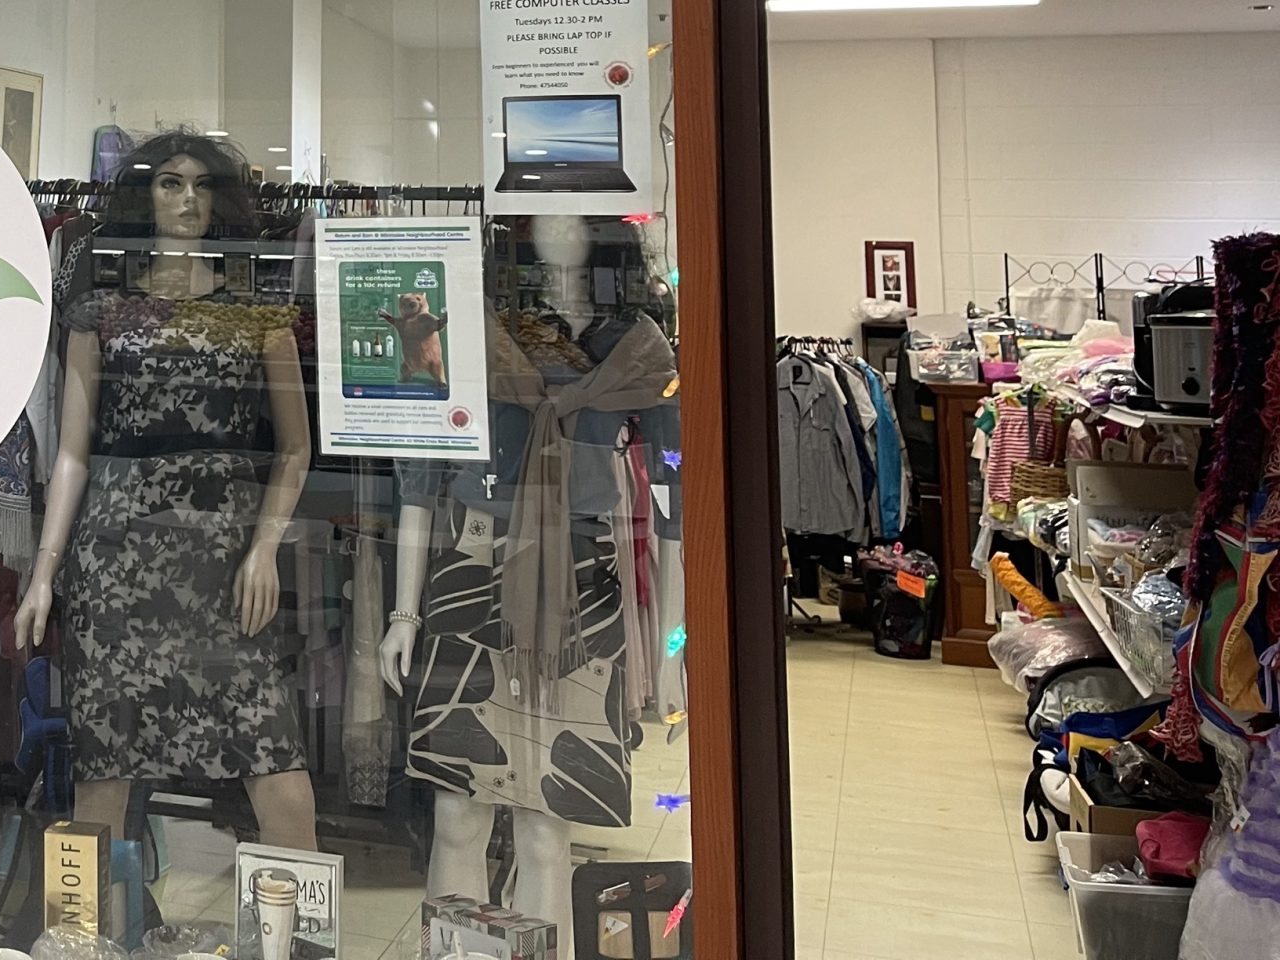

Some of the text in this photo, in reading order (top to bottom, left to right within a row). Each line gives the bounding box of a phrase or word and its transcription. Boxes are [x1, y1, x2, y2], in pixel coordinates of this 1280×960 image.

[490, 0, 512, 10] FREE
[515, 17, 552, 26] Tuesdays
[507, 34, 535, 42] PLEASE
[539, 47, 578, 55] POSSIBLE
[61, 842, 81, 924] NHOFF
